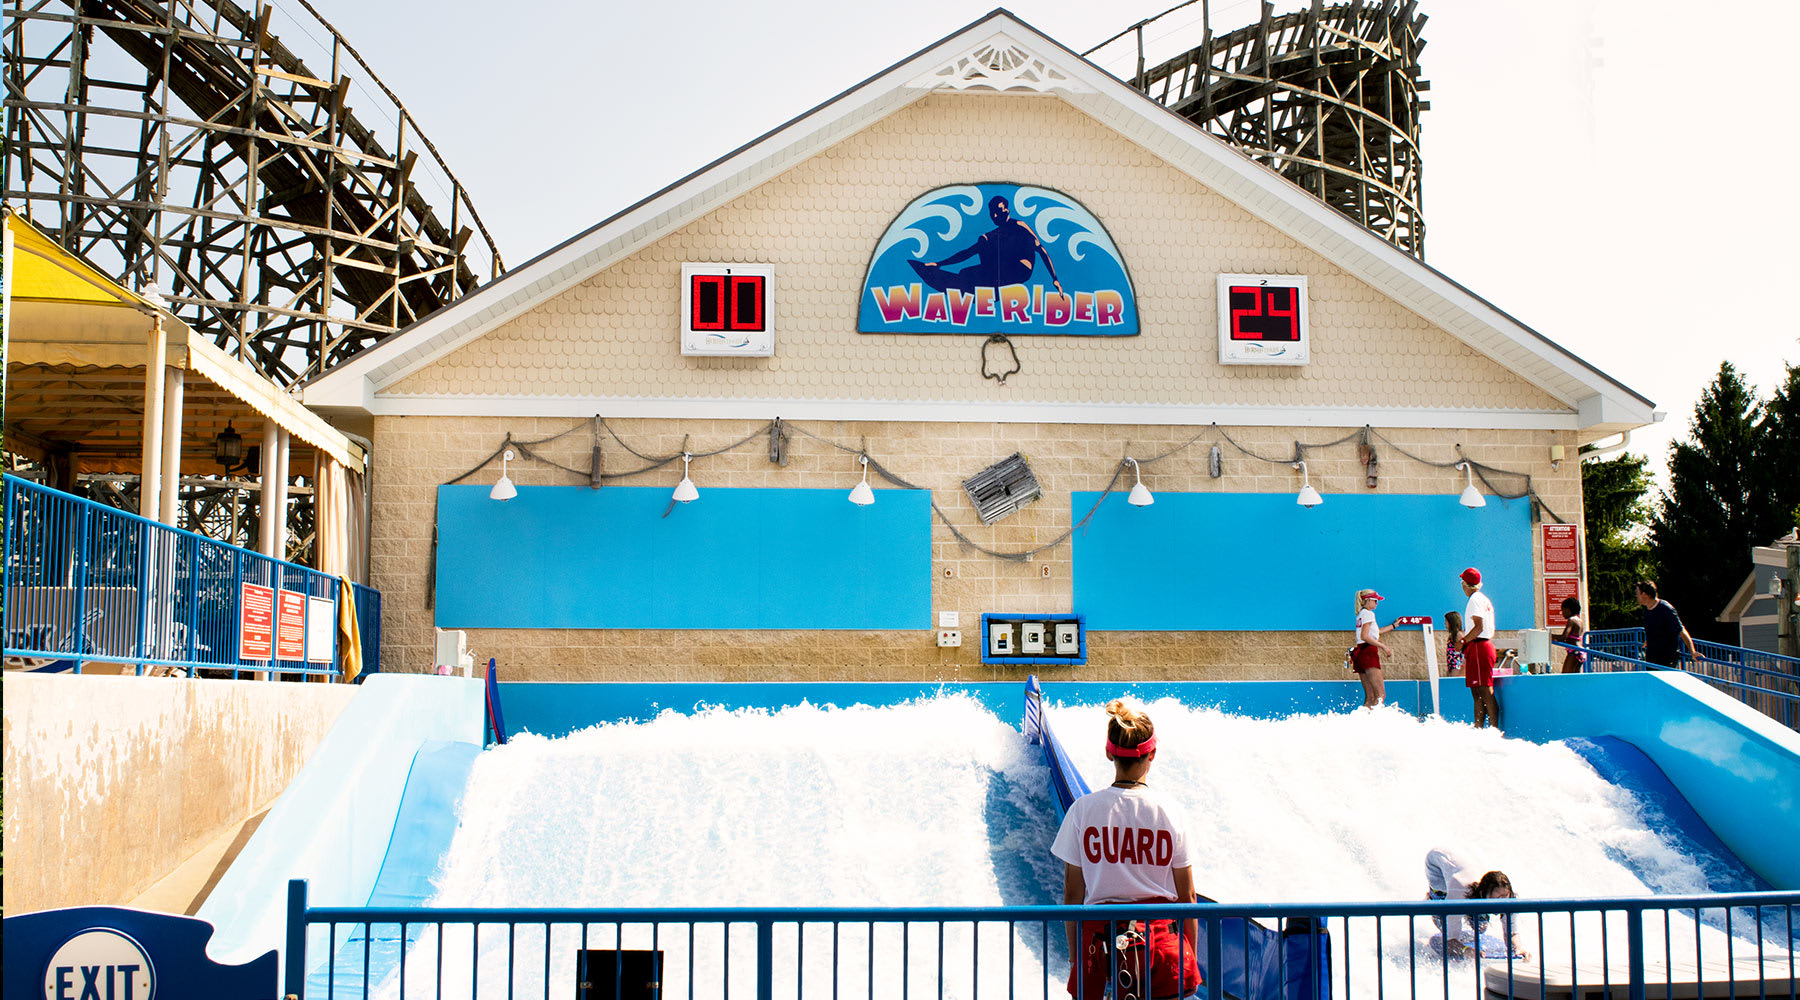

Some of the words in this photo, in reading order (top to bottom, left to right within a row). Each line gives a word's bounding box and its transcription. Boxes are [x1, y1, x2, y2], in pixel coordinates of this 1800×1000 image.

[692, 275, 762, 330] 00
[1231, 286, 1299, 340] 24
[1083, 826, 1173, 867] GUARD
[55, 964, 140, 1000] EXIT
